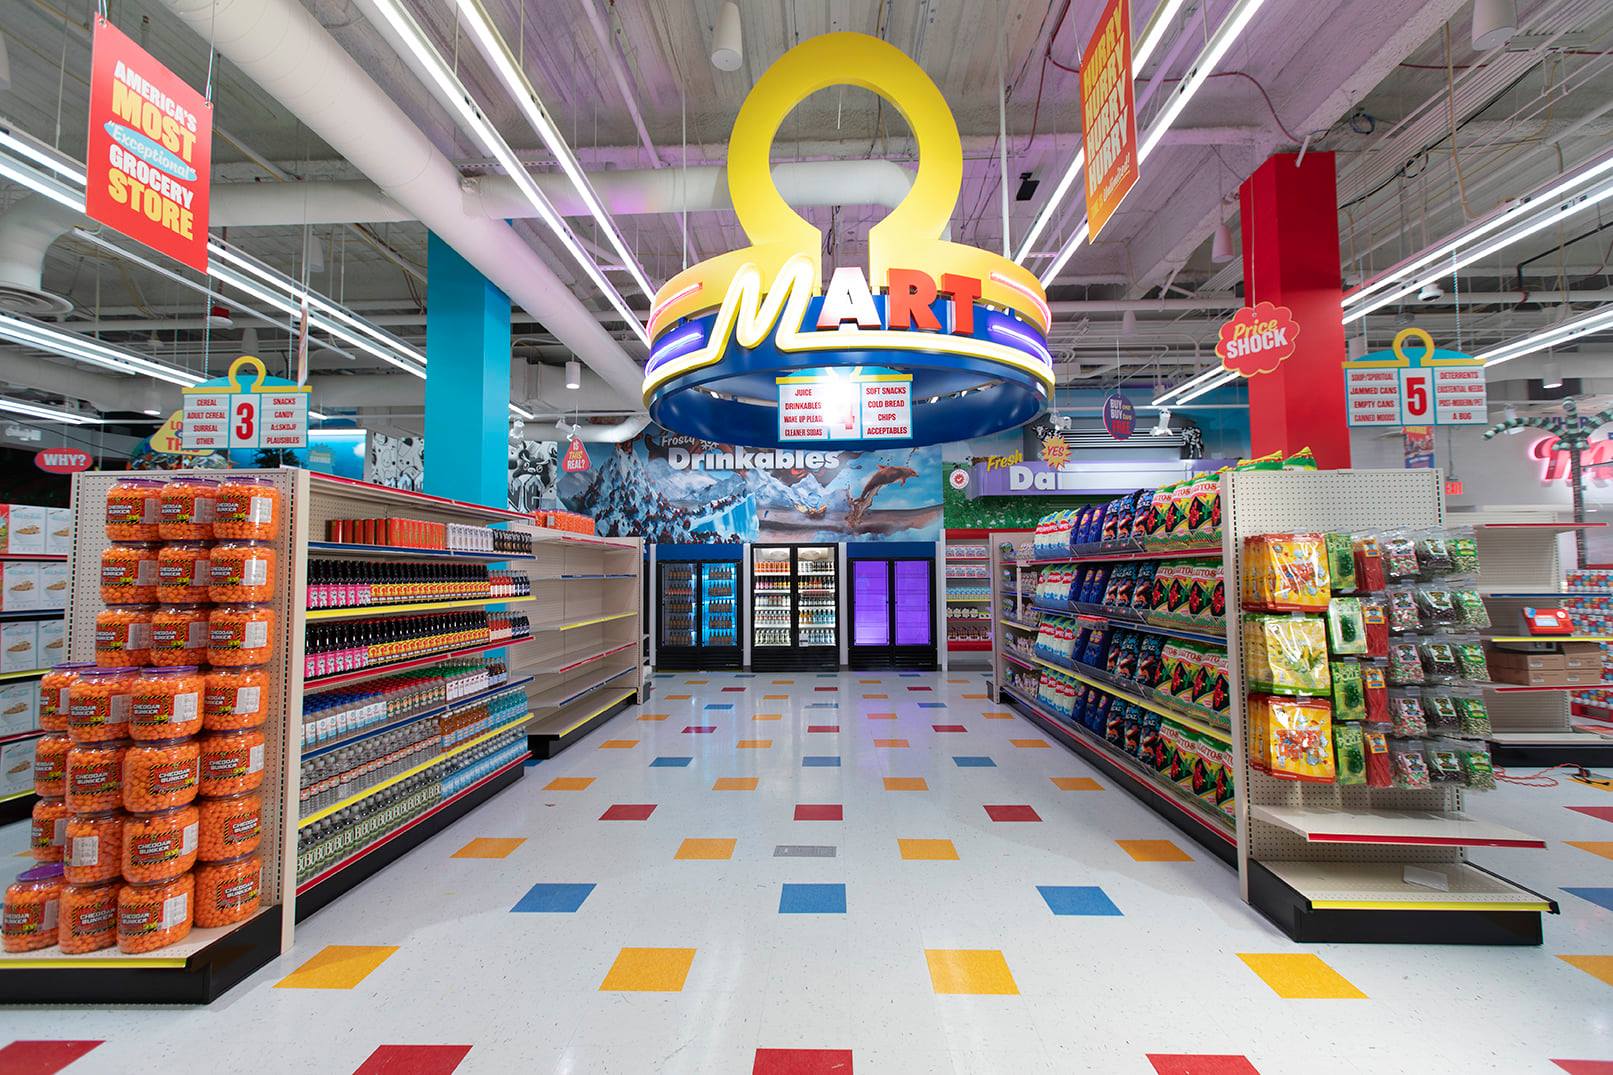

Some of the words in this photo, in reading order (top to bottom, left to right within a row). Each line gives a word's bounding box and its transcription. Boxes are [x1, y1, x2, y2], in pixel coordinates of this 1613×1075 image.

[1084, 0, 1122, 101] HURRY
[1085, 32, 1124, 134] HURRY
[114, 60, 197, 132] AMERICA'S
[112, 78, 197, 162] MOST
[1086, 68, 1126, 165] HURRY
[1087, 104, 1128, 197] HURRY
[109, 143, 194, 209] GROCERY
[108, 167, 193, 241] STORE
[703, 254, 983, 358] MART
[1234, 319, 1278, 340] Price
[1226, 327, 1288, 359] SHOCK
[794, 388, 813, 397] JUICE
[866, 387, 880, 395] SOFT
[881, 386, 907, 395] SNACKS
[1350, 387, 1378, 395] JAMMED
[1406, 377, 1427, 416] 5
[785, 402, 822, 410] DRINKABLES
[868, 400, 883, 408] COLD
[884, 400, 905, 408] BREAD
[1354, 400, 1375, 408] EMPTY
[1377, 400, 1394, 408] CANS
[235, 402, 255, 440] 3
[784, 415, 798, 423] WAKE
[799, 415, 806, 423] UP
[878, 413, 896, 421] CHIPS
[1459, 412, 1472, 420] BUG
[784, 428, 806, 437] CLEANER
[806, 428, 823, 436] SODAS
[867, 426, 908, 435] ACCEPTABLES
[572, 440, 579, 450] IS
[661, 435, 695, 448] Frosty
[568, 451, 583, 459] THIS
[668, 445, 840, 470] Drinkables
[1047, 447, 1065, 457] YES
[43, 453, 86, 466] WHY?
[567, 460, 585, 469] REAL?
[986, 449, 1024, 472] Fresh
